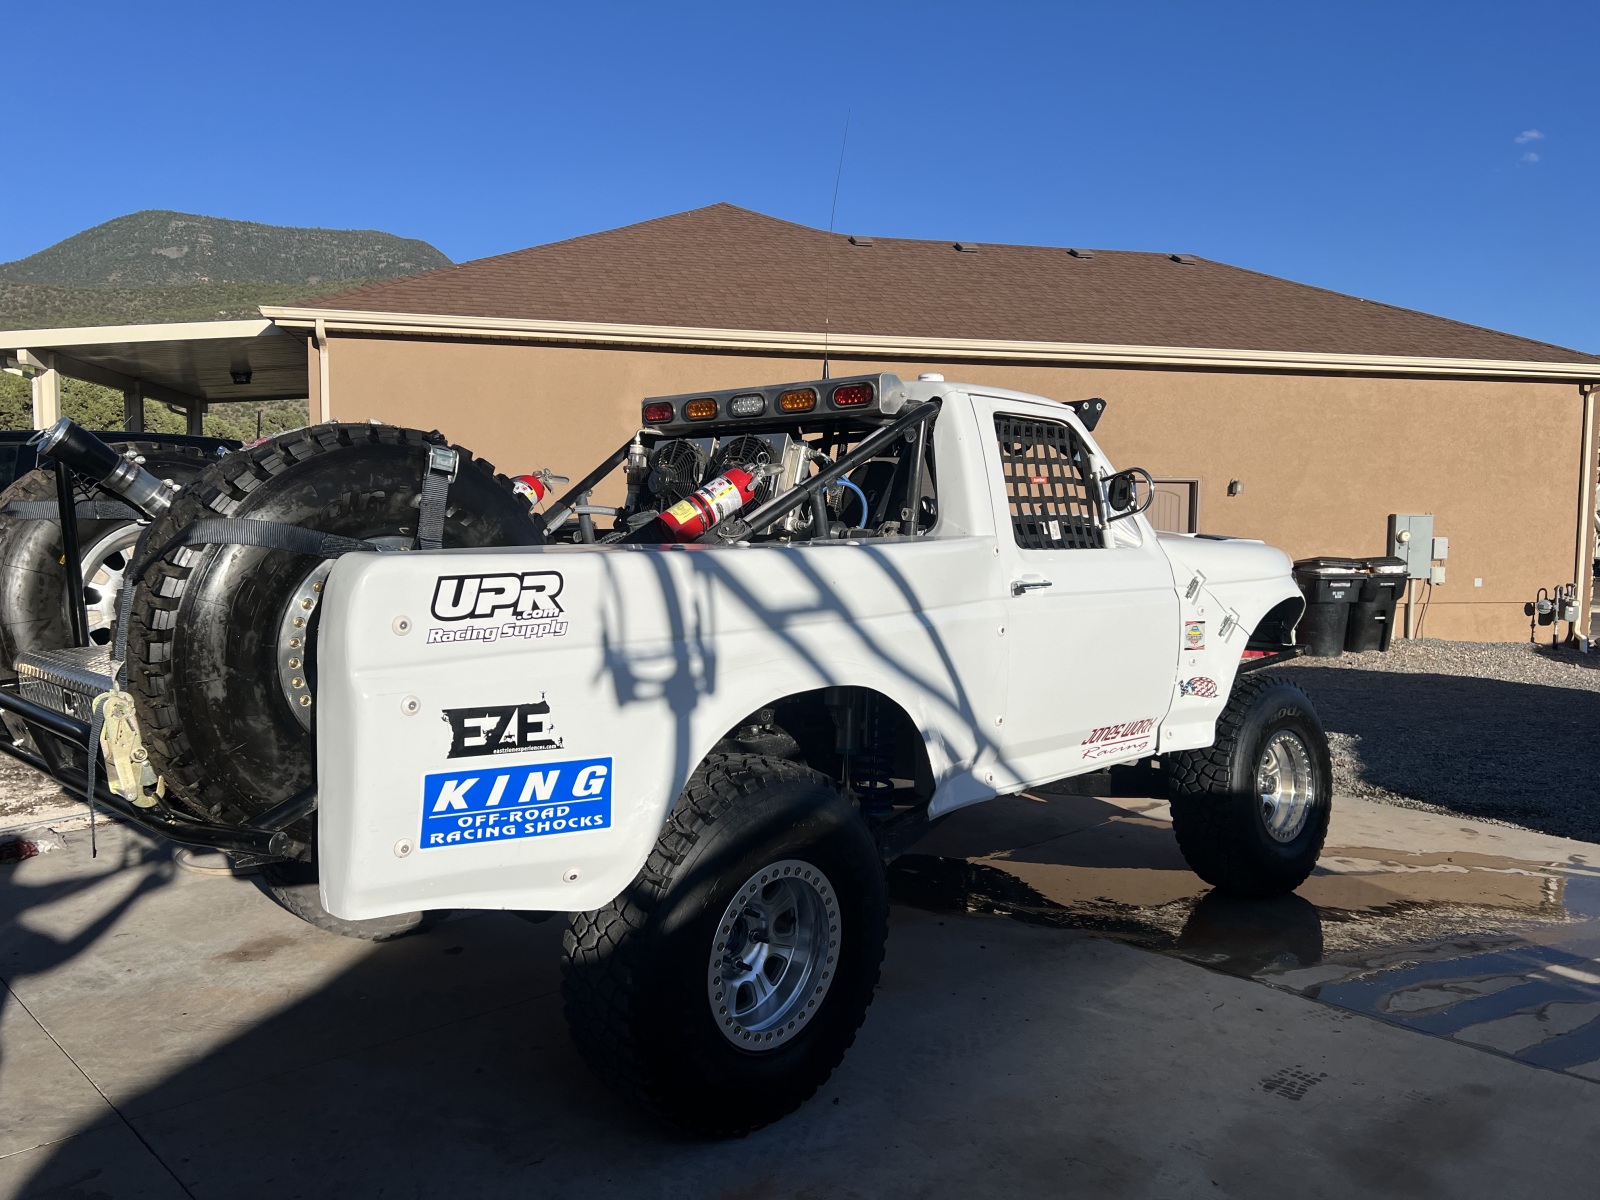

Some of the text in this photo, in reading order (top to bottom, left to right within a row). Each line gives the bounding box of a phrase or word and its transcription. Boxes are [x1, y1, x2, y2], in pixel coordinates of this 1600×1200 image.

[431, 571, 565, 621] UPR
[515, 607, 560, 620] .com
[427, 620, 568, 644] Racing Supply
[1082, 741, 1149, 759] Racing
[432, 765, 608, 812] KING
[458, 806, 570, 827] OFF-ROAD
[430, 814, 604, 845] RACING SHOCKS
